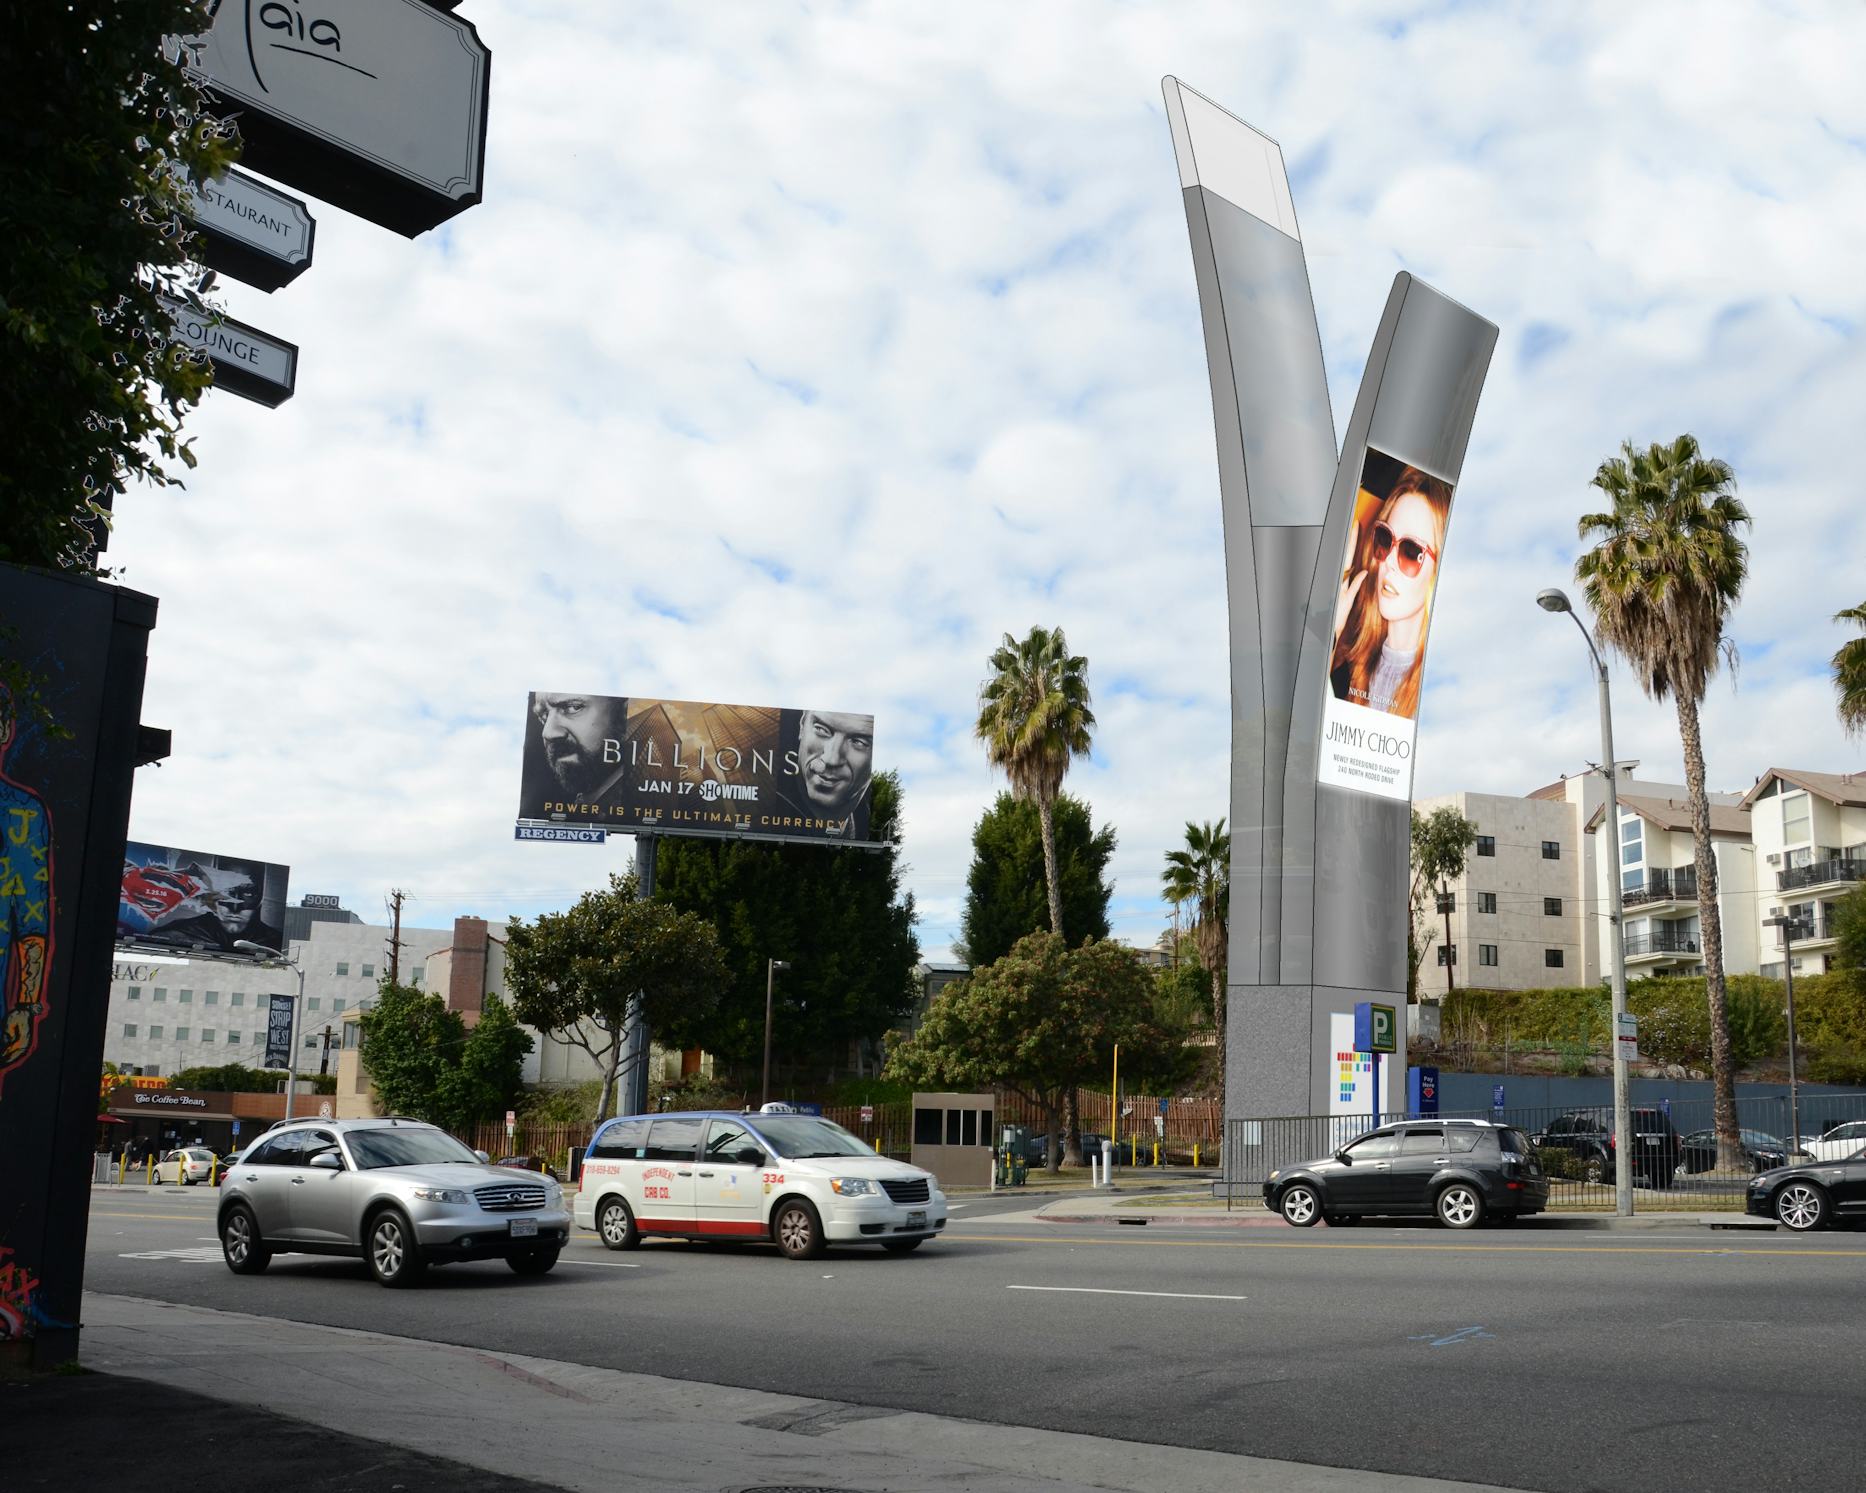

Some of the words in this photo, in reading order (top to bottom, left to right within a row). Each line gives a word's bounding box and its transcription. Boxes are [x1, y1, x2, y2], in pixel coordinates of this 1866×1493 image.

[205, 188, 292, 237] STAURANT
[1326, 721, 1366, 748] JIMMY
[1367, 732, 1410, 759] CHOO
[603, 738, 800, 776] BILLIONS
[1333, 753, 1349, 764] NEWLY
[1349, 757, 1379, 772] REDESIGNED
[1378, 764, 1401, 776] FLAGSHIP
[1348, 767, 1364, 778] NORTH
[1364, 771, 1381, 782] RODEO
[638, 779, 672, 794] JAN
[677, 781, 694, 795] 17
[699, 779, 759, 802] SHOWTIME
[544, 802, 599, 815] POWER
[609, 806, 624, 816] IS
[634, 807, 663, 819] THE
[672, 810, 751, 825] ULTIMATE
[761, 815, 848, 831] CURRENCY
[519, 827, 600, 842] REGENCY
[306, 895, 338, 906] 9000
[270, 1010, 291, 1028] STRIP
[1374, 1011, 1388, 1045] P
[270, 1029, 290, 1045] WEST
[1423, 1075, 1434, 1084] Pay
[134, 1094, 150, 1104] The
[151, 1095, 179, 1105] Coffee
[180, 1096, 206, 1107] Bean
[642, 1168, 675, 1182] INDEPENDENT
[763, 1173, 784, 1184] 334
[644, 1187, 658, 1198] CAB
[659, 1187, 671, 1199] CO.
